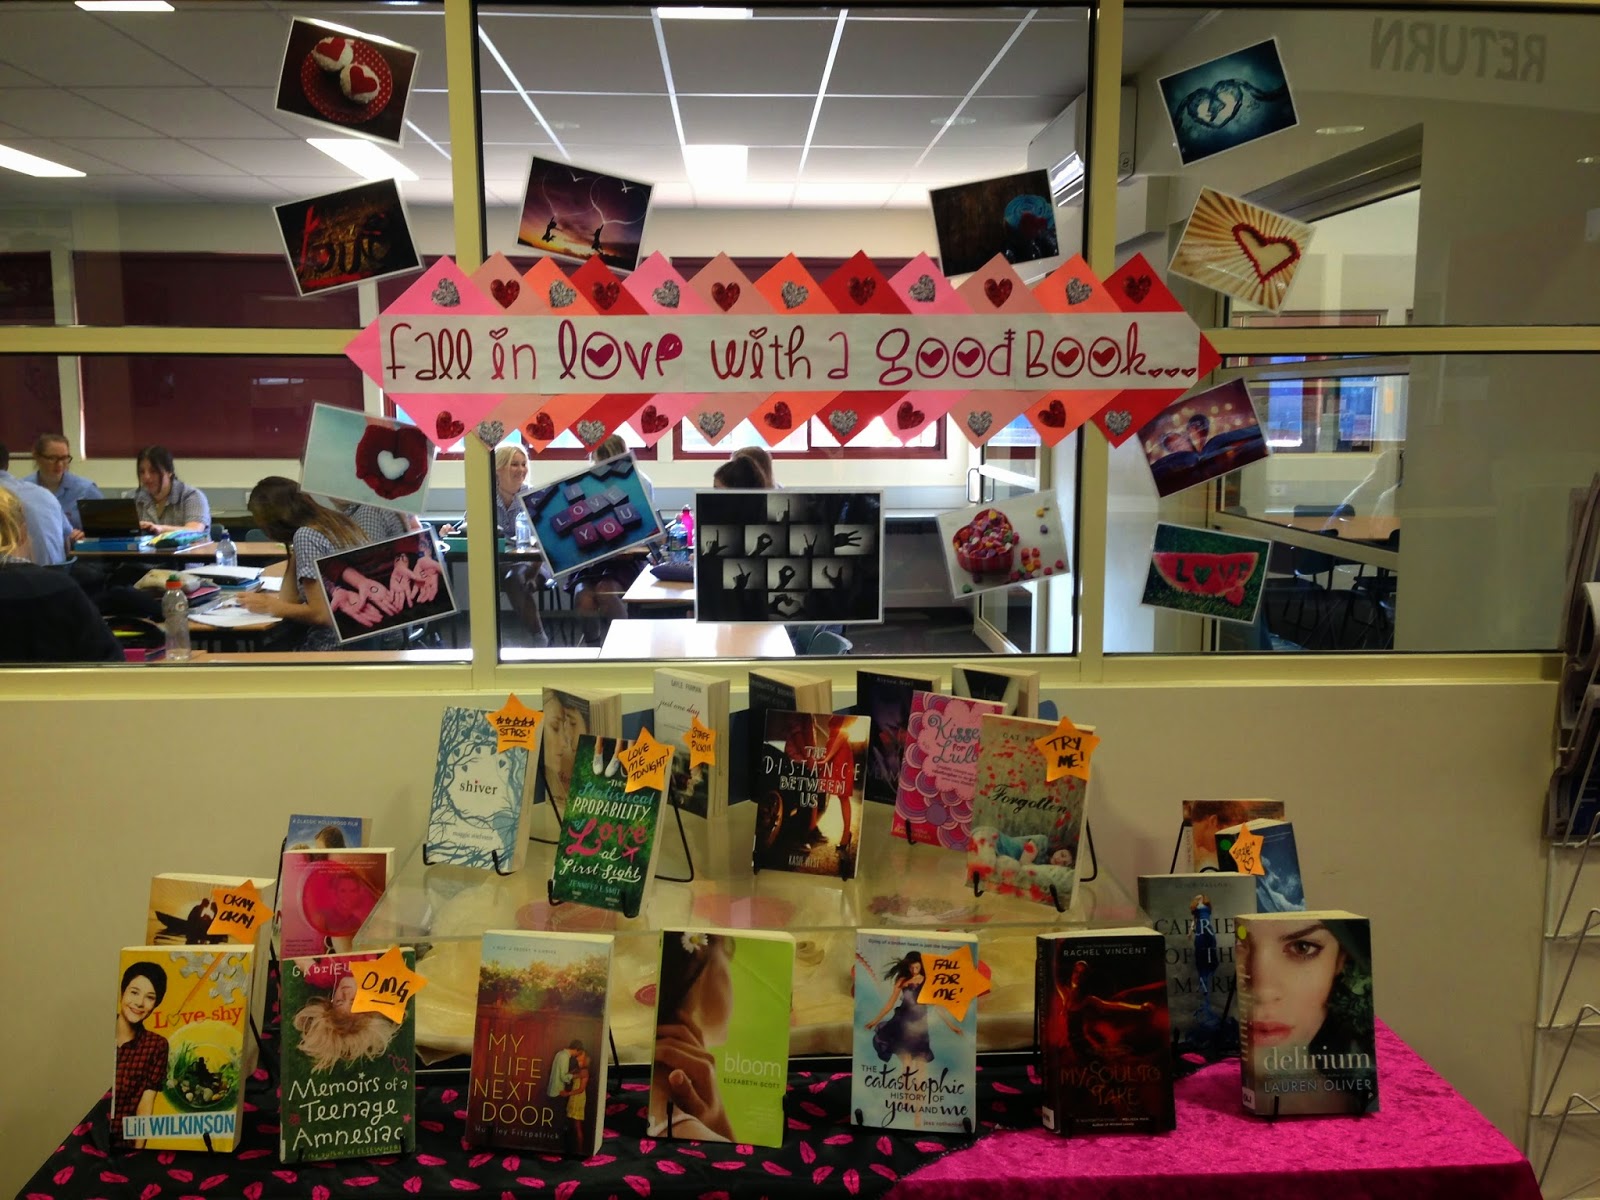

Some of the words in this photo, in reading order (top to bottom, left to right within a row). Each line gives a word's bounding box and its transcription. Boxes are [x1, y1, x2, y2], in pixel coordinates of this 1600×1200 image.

[386, 323, 472, 380] fall
[489, 327, 537, 380] in
[558, 319, 683, 380] love
[711, 326, 811, 380] with
[828, 331, 849, 380] a
[876, 328, 1016, 386] good
[579, 508, 632, 541] YOU
[687, 703, 700, 718] day
[692, 727, 710, 741] STAFF
[928, 714, 981, 743] Kisse
[627, 742, 650, 762] LOVE
[952, 743, 966, 751] for
[1045, 736, 1082, 750] TRY
[804, 746, 827, 759] THE
[1057, 751, 1084, 769] ME!
[628, 758, 645, 773] ME
[459, 780, 498, 795] shiver
[779, 776, 846, 795] BETWEEN
[800, 792, 819, 808] US
[987, 783, 1068, 814] Forgotten
[572, 796, 651, 822] PROBABILITY
[566, 818, 648, 856] Love
[599, 847, 622, 861] at
[559, 857, 600, 875] First
[601, 863, 641, 884] Sight
[604, 886, 621, 896] SMIT
[1154, 918, 1235, 936] CARRIE
[1063, 948, 1099, 957] RACHEL
[1105, 946, 1147, 955] VINCENT
[1166, 947, 1194, 965] OF
[1199, 947, 1234, 964] TH
[933, 959, 960, 970] FALL
[932, 973, 960, 985] FOR
[933, 987, 964, 1004] ME!
[488, 1032, 524, 1054] MY
[494, 1056, 543, 1079] LIFE
[724, 1052, 781, 1078] bloom
[1263, 1046, 1371, 1071] delirium
[861, 1065, 877, 1073] THE
[1061, 1065, 1088, 1085] MY
[288, 1076, 380, 1101] Memoirs
[384, 1076, 400, 1091] of
[401, 1080, 408, 1090] a
[473, 1079, 536, 1102] NEXT
[723, 1077, 758, 1087] ELIZABETH
[760, 1081, 780, 1089] SCOTT
[864, 1064, 965, 1104] catastrophic
[1264, 1080, 1318, 1093] LAUREN
[1323, 1079, 1372, 1092] OLIVER
[890, 1092, 926, 1101] HISTORY
[932, 1095, 945, 1103] OF
[1090, 1085, 1138, 1104] TAKE
[299, 1099, 399, 1126] Teenage
[482, 1102, 554, 1128] DOOR
[881, 1100, 917, 1127] you
[918, 1106, 938, 1115] AND
[940, 1105, 968, 1116] me
[125, 1117, 146, 1137] Lili
[150, 1113, 235, 1136] WILKINSON
[511, 1128, 560, 1140] Fitzpatrick
[292, 1126, 404, 1151] Amnesiac
[357, 1144, 401, 1155] ELSEWHER
